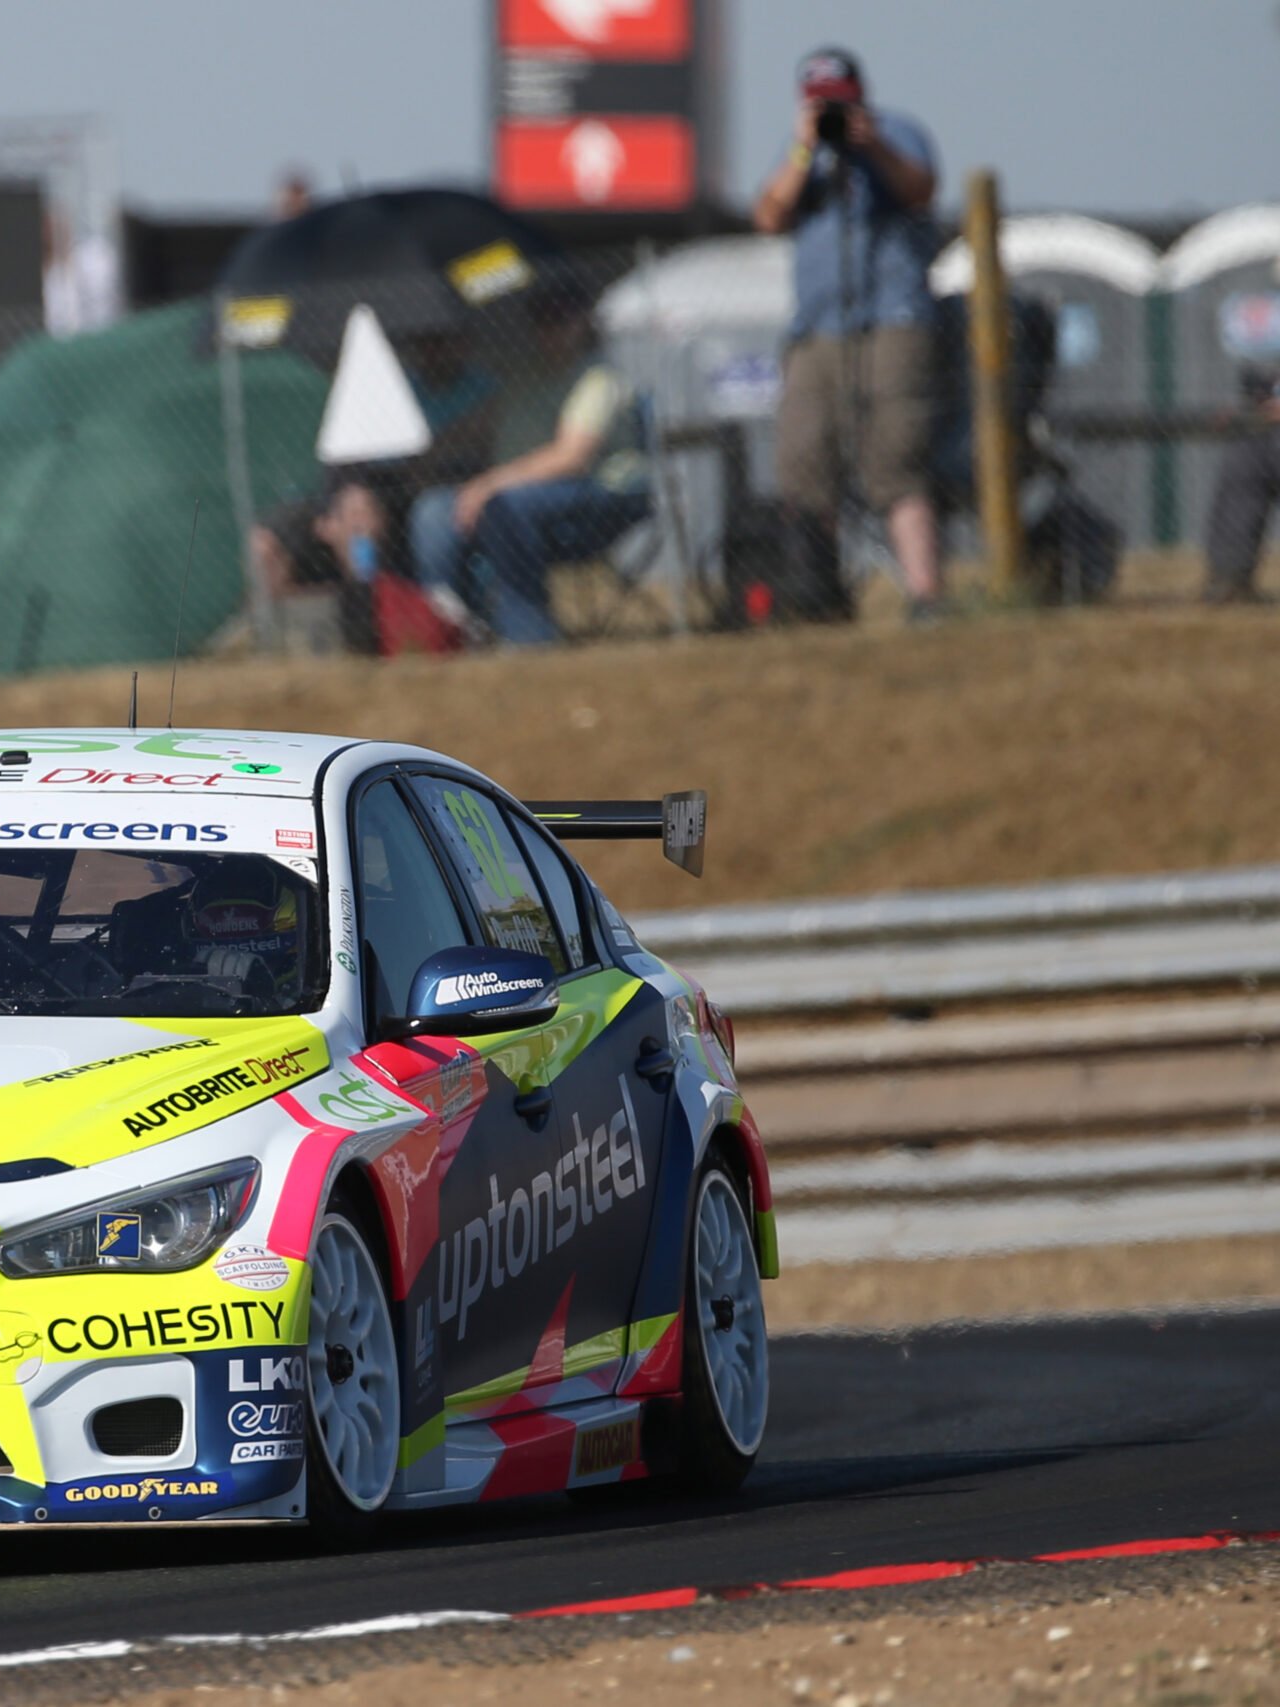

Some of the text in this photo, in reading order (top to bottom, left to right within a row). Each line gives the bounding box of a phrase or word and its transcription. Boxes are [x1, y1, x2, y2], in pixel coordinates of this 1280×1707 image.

[38, 768, 302, 786] Direct
[340, 885, 355, 954] PILKINGTON
[466, 971, 498, 986] Auto
[466, 978, 544, 998] Windscreens
[122, 1047, 310, 1138] AUTOBRITE Direct
[438, 1073, 646, 1341] uptonsteel
[217, 1261, 287, 1277] SCAFFOLDING
[47, 1301, 285, 1353] COHESITY
[228, 1356, 305, 1392] LKQ
[237, 1445, 275, 1459] CAR
[65, 1478, 218, 1502] GOODYEAR
